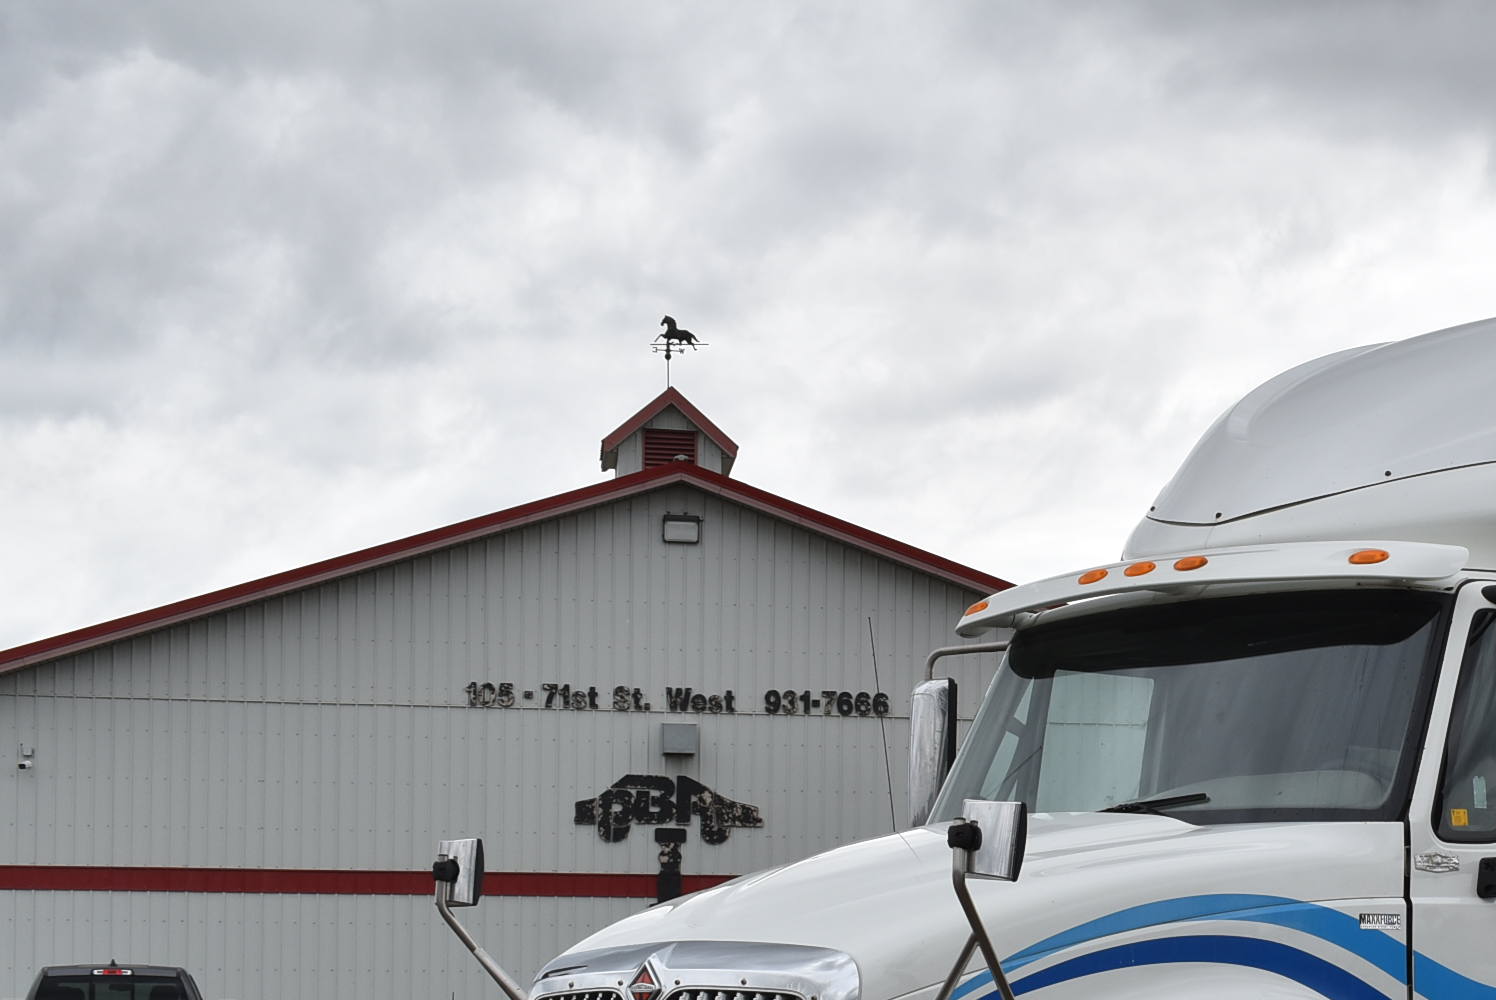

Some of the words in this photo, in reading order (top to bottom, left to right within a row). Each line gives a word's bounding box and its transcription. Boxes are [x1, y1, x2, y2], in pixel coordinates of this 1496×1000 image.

[542, 683, 599, 710] 71st
[613, 686, 650, 711] St.
[665, 686, 736, 712] West
[764, 689, 890, 717] 931-7666
